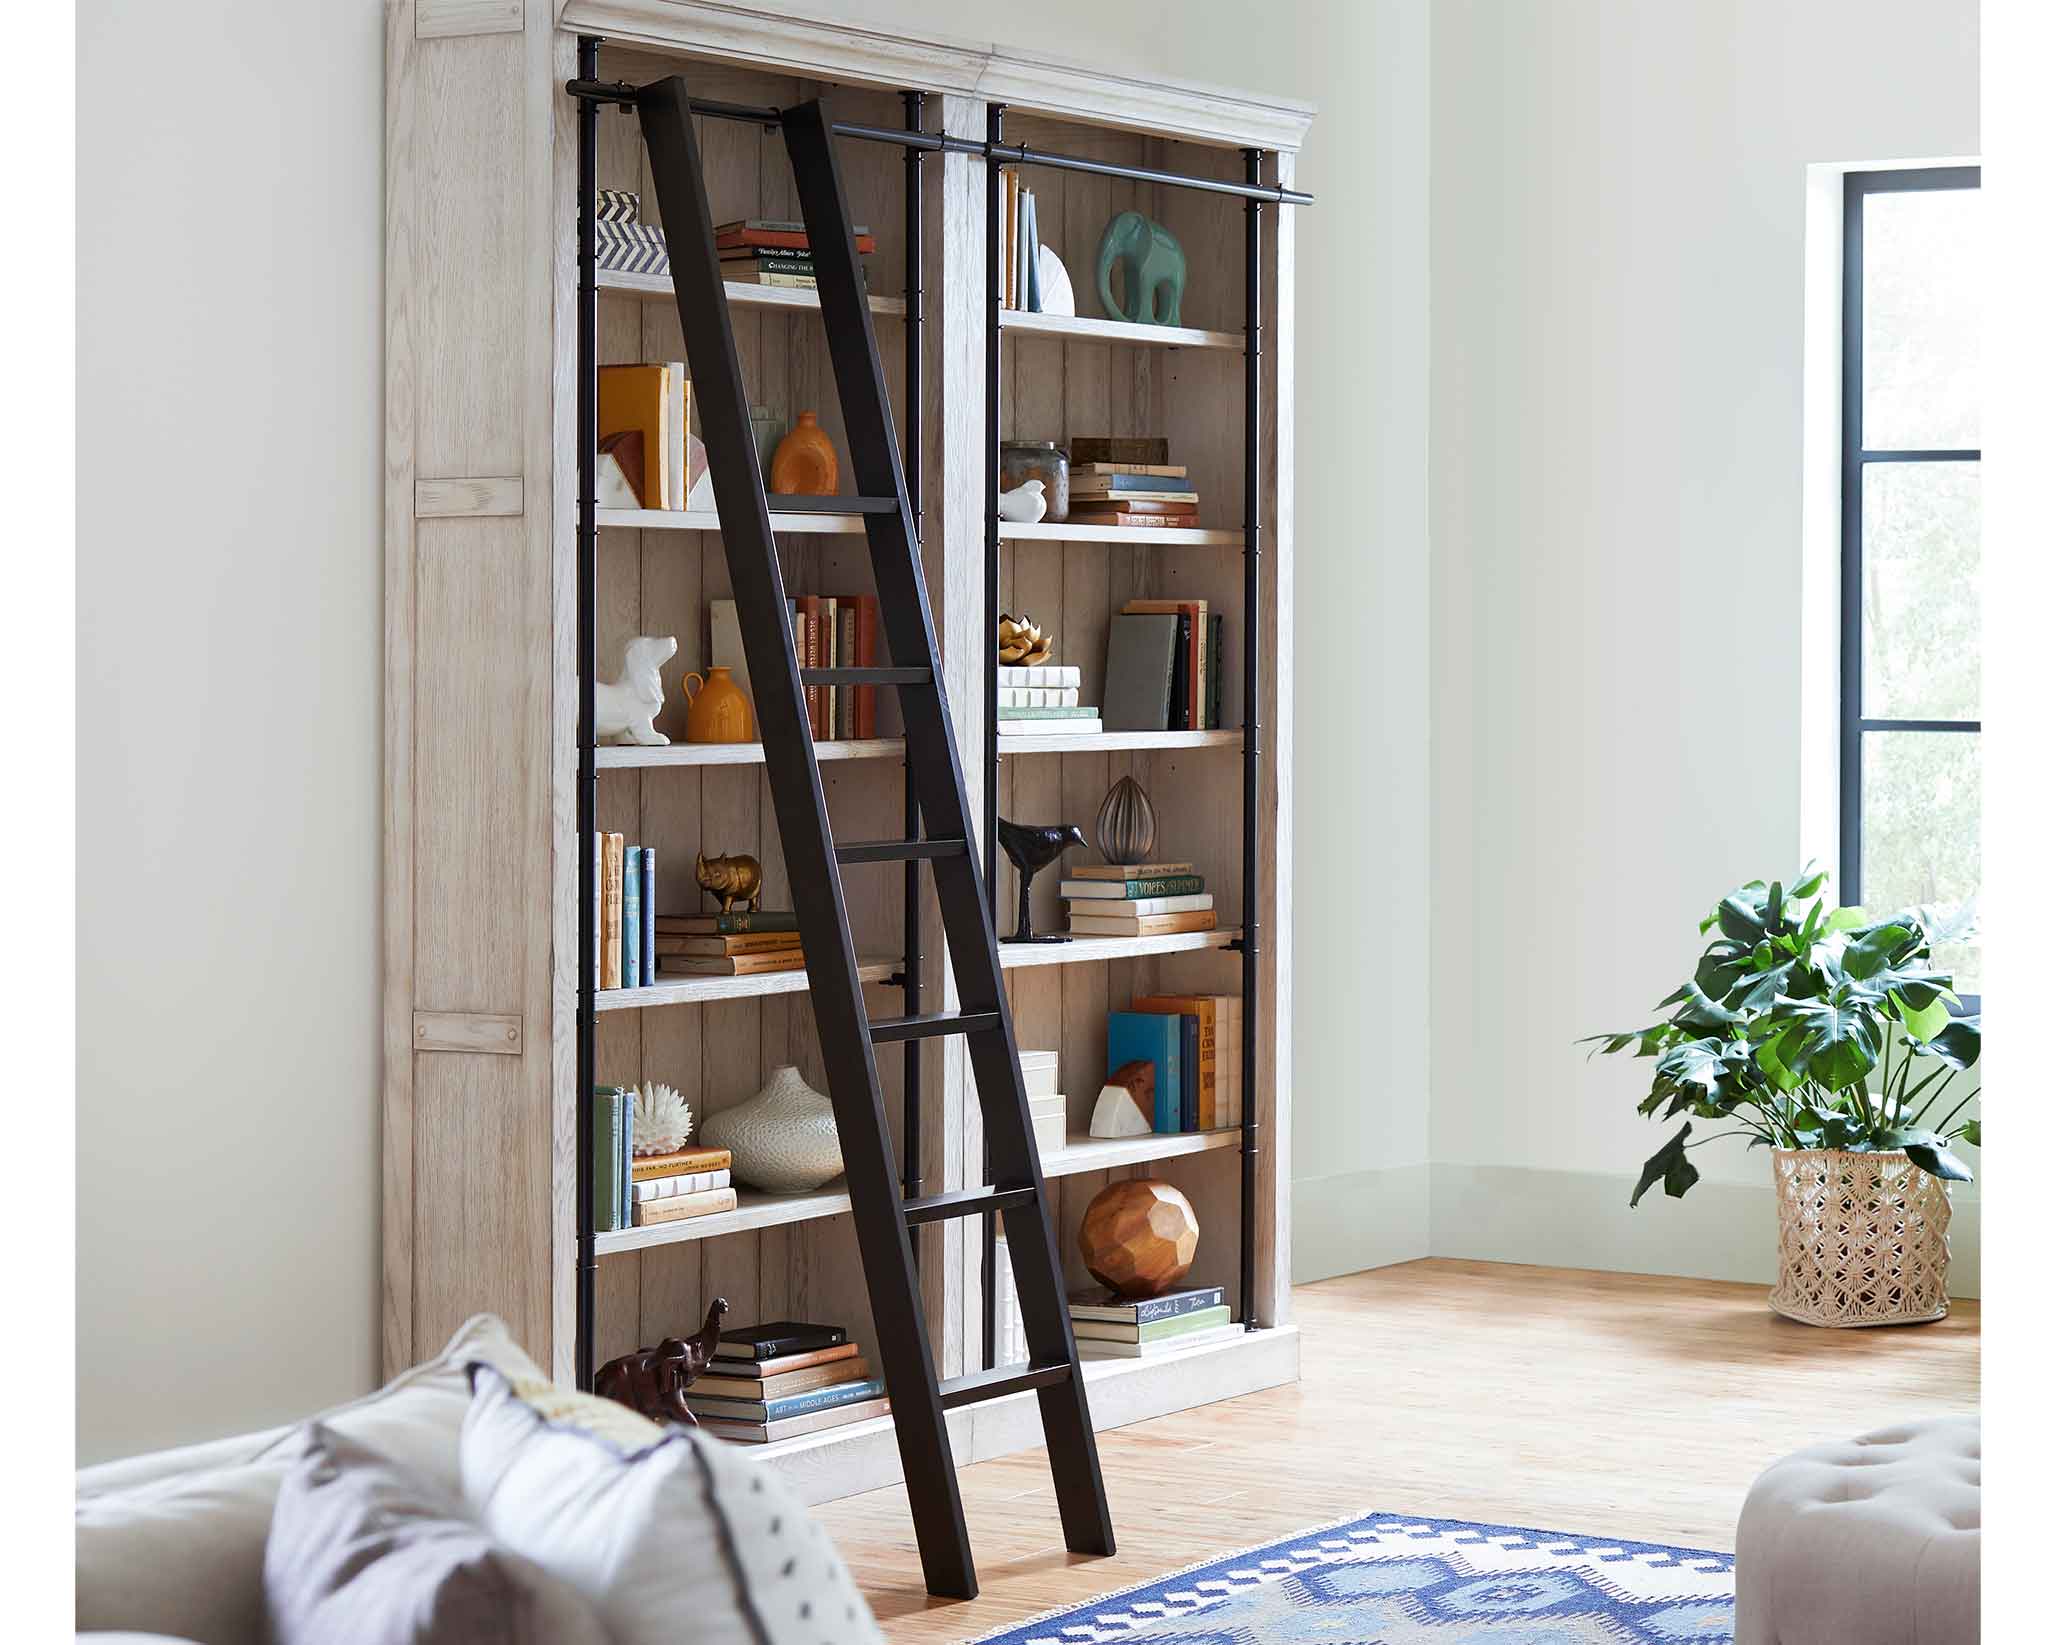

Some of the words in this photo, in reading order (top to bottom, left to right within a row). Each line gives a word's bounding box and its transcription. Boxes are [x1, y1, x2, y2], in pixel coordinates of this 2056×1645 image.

[668, 1160, 692, 1168] FURTHER
[775, 1404, 787, 1415] ART
[799, 1398, 822, 1409] MIDDLE
